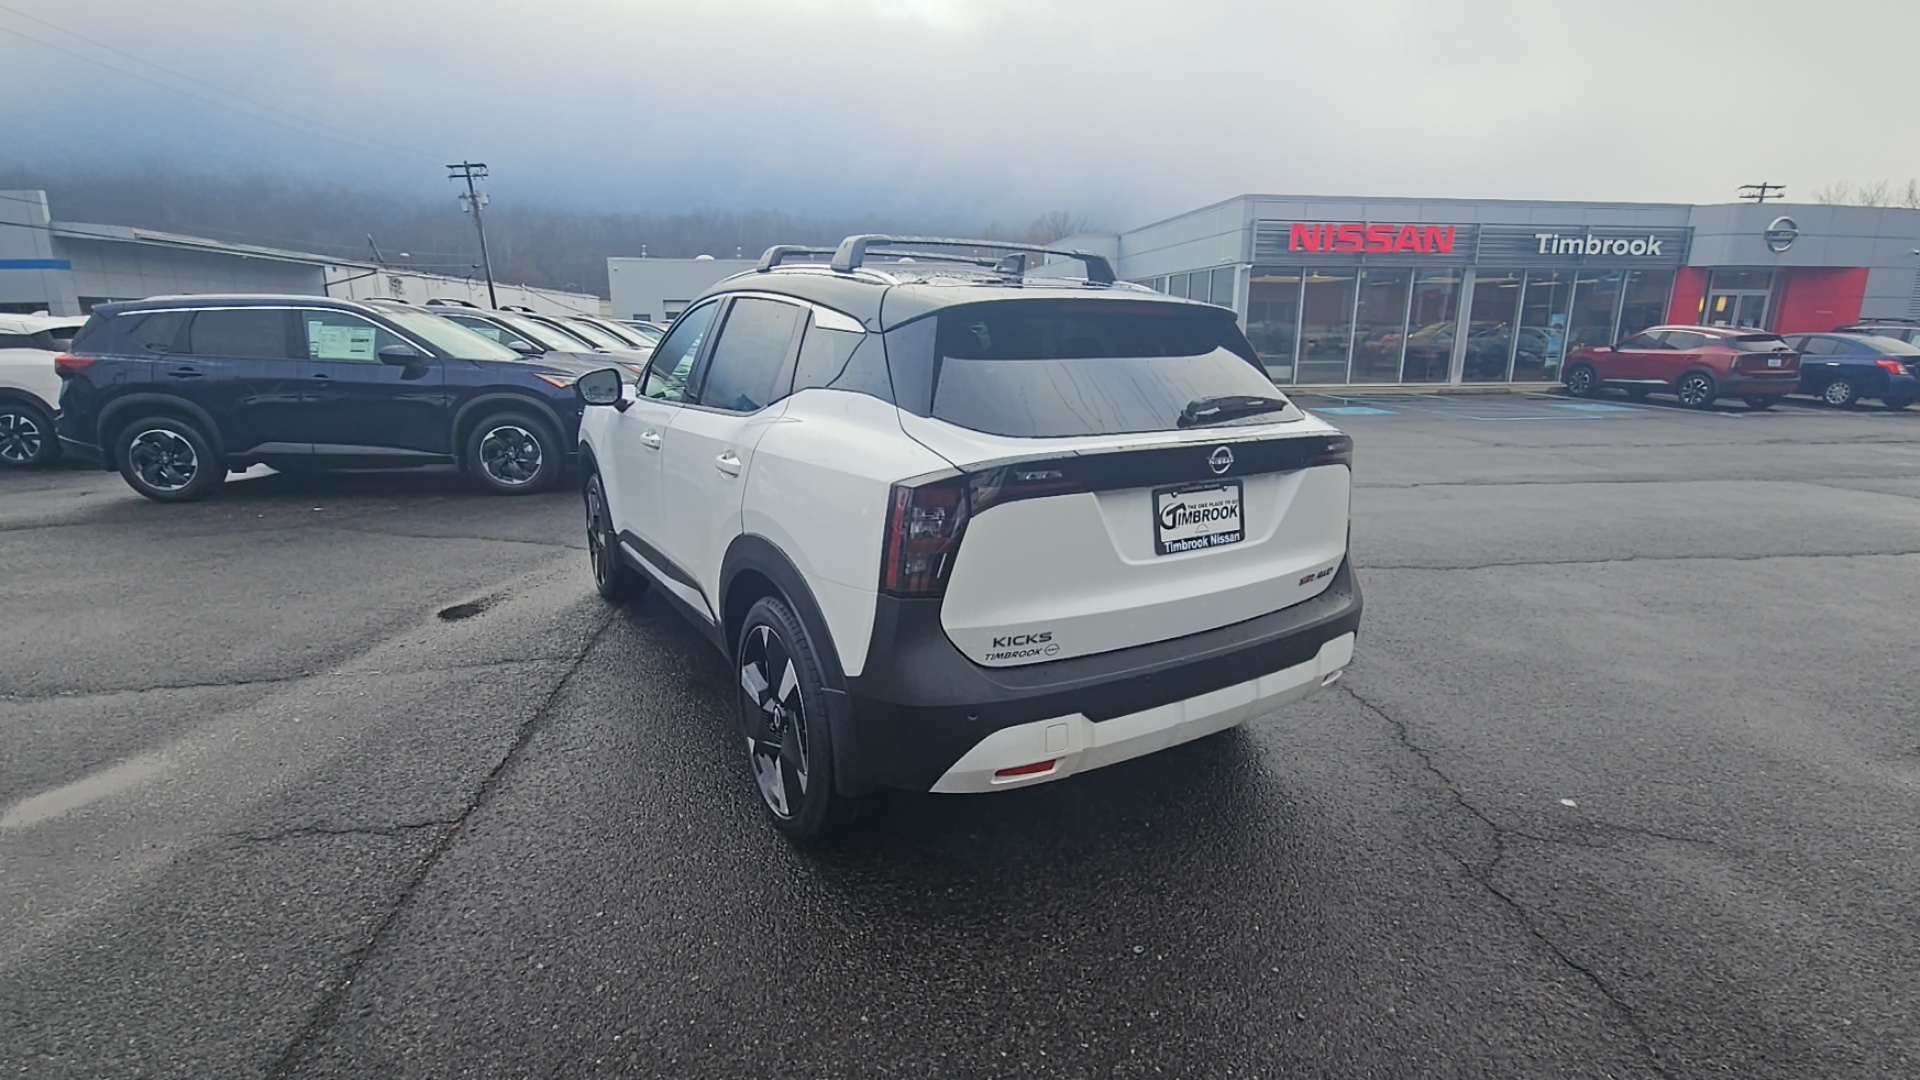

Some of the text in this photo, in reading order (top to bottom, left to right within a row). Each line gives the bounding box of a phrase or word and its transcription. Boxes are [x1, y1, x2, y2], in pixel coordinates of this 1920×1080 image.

[1289, 223, 1457, 255] NISSAN
[1534, 233, 1663, 256] Timbrook
[1160, 503, 1238, 530] TIMBROOK
[1164, 532, 1240, 553] Timbrook Nissan
[993, 631, 1052, 648] KICKS
[985, 648, 1043, 661] TIMBROOK
